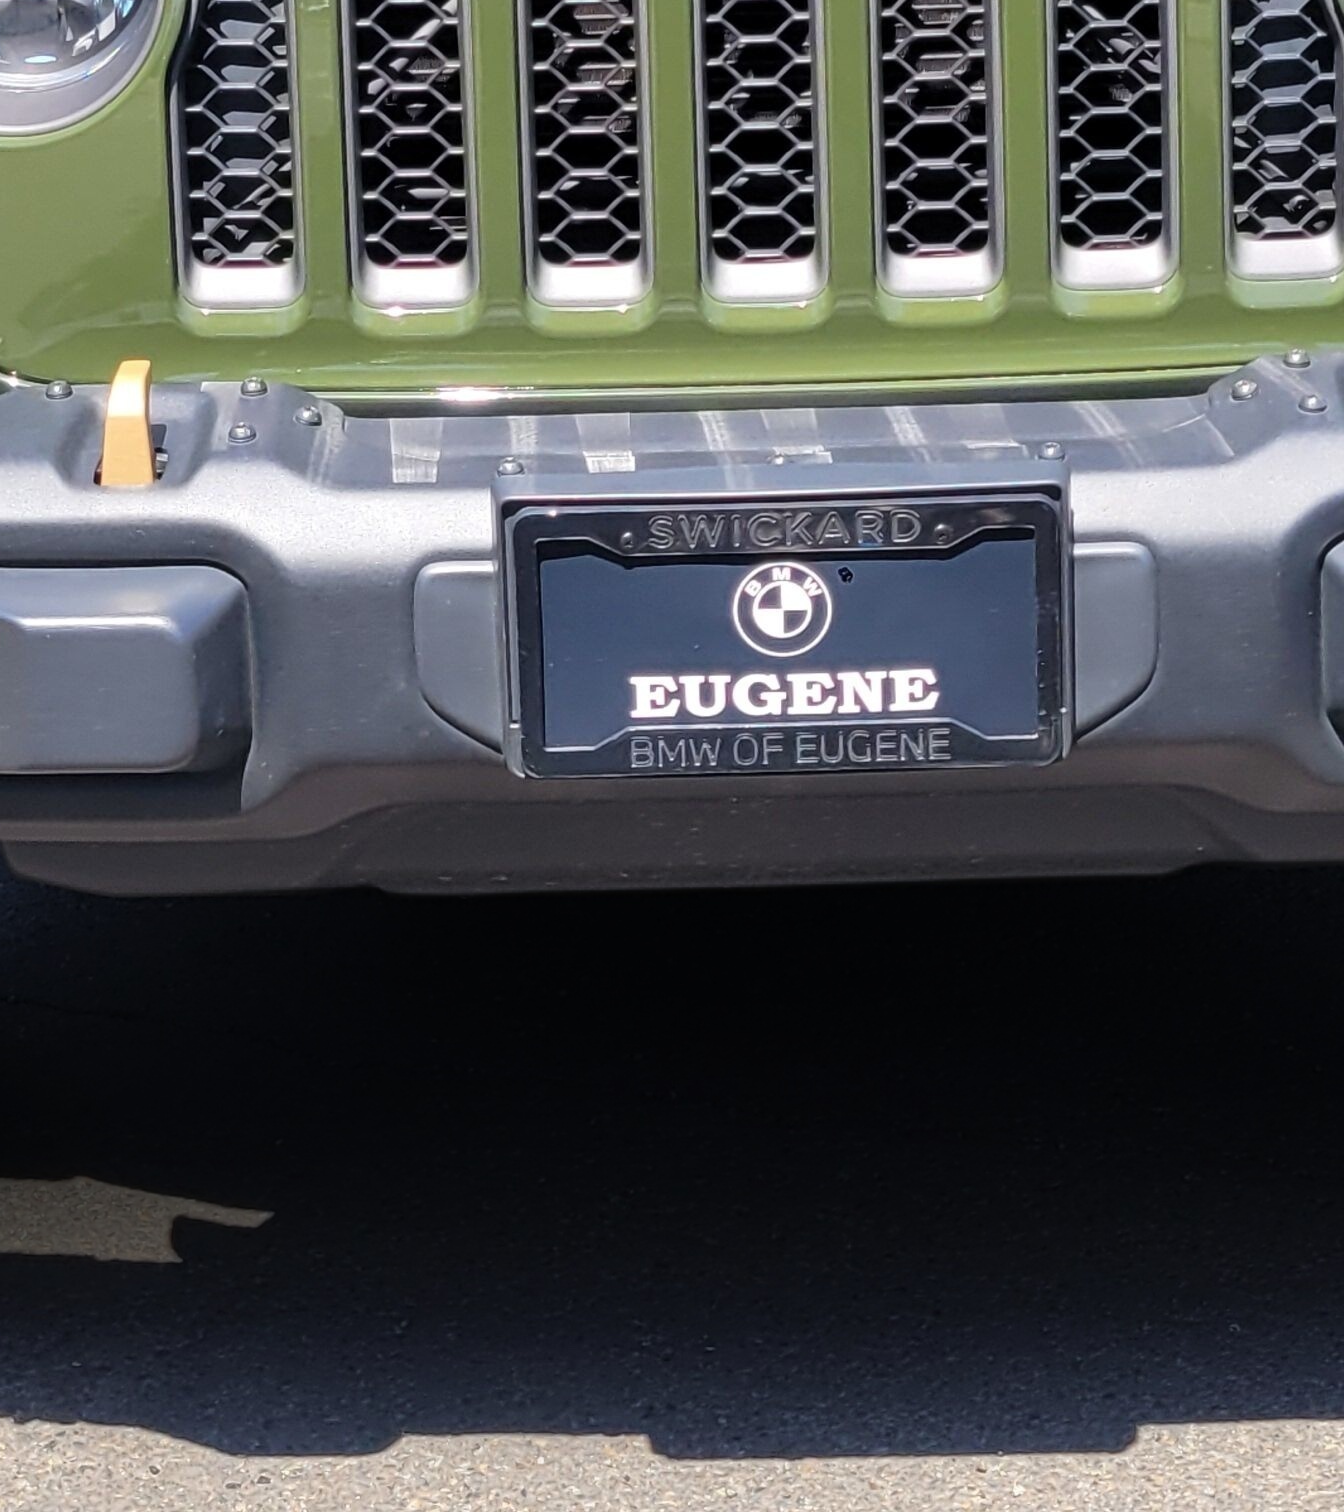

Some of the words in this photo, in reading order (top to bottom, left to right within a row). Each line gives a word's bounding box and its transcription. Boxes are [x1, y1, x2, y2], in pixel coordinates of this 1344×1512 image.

[647, 509, 923, 550] SWICKARD
[744, 567, 823, 597] BMW
[628, 668, 940, 720] EUGENE
[629, 736, 722, 768] BMW
[732, 734, 785, 765] OF
[795, 727, 952, 764] EUGENE
